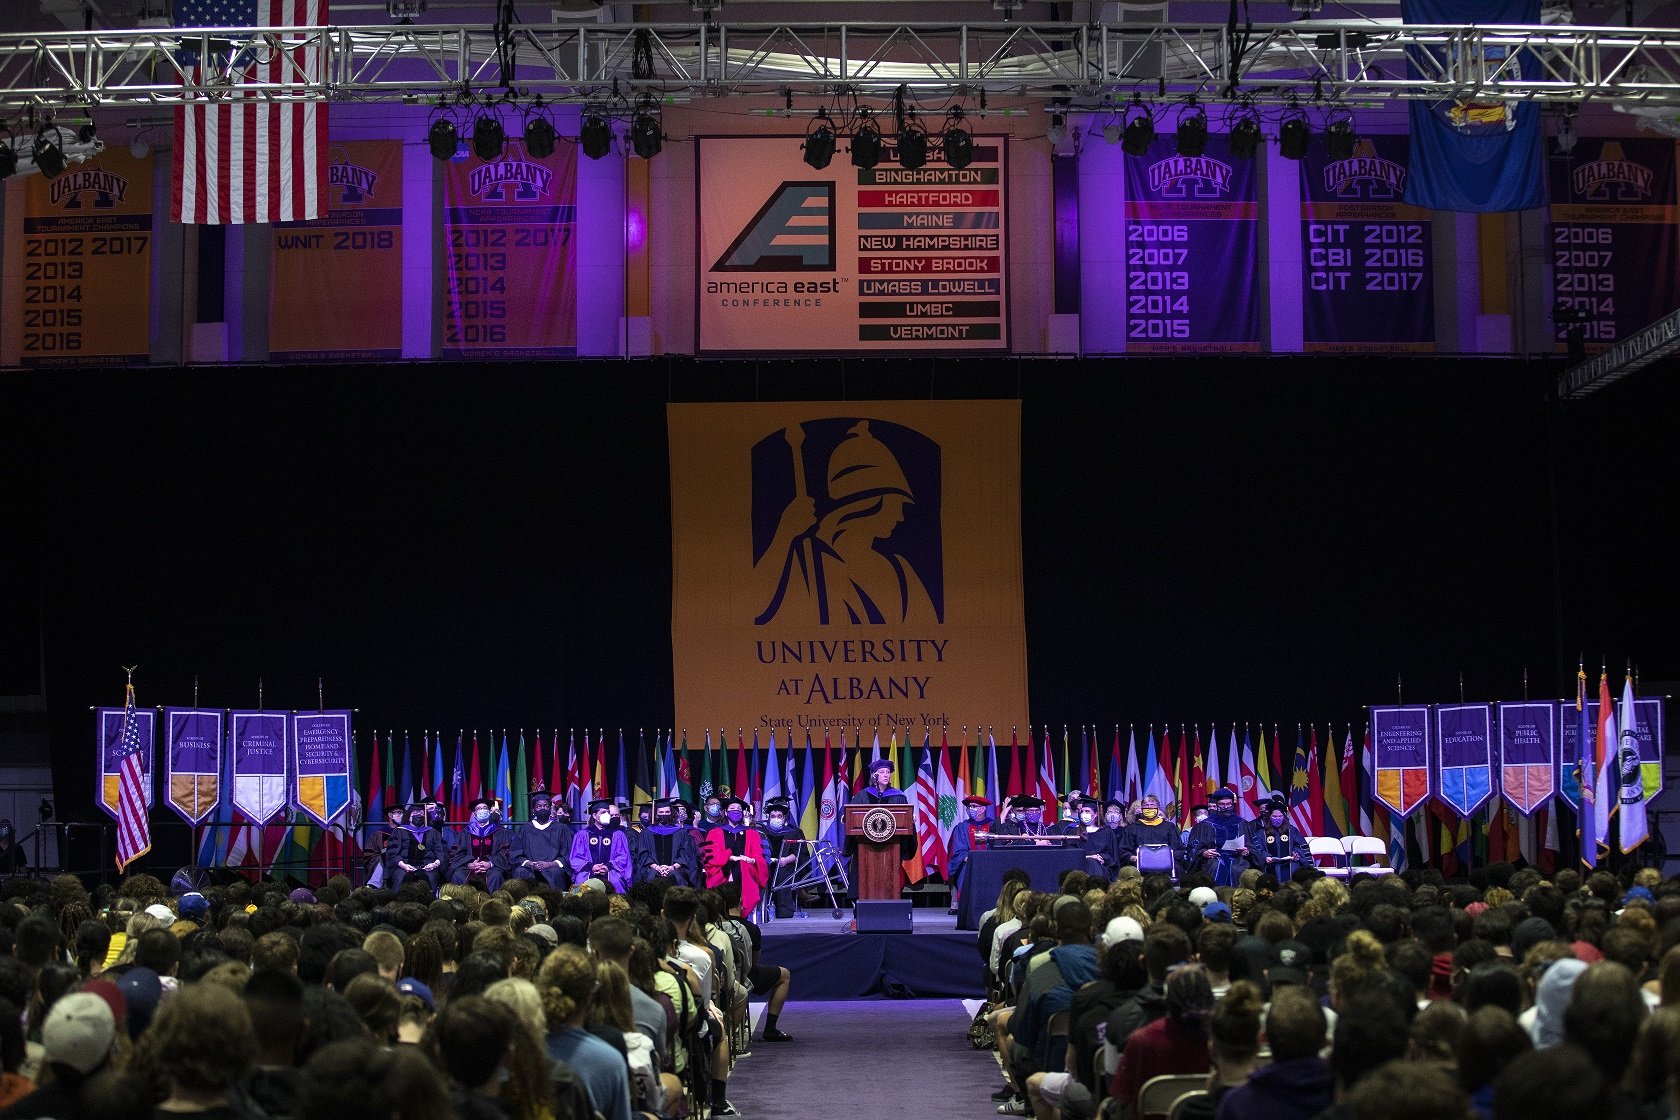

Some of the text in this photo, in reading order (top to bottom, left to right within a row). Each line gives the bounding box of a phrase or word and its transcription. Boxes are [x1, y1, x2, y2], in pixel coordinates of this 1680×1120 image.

[329, 165, 377, 198] BANY
[471, 161, 552, 196] UALBANY
[875, 170, 981, 183] BINGHAMTON
[1150, 157, 1232, 191] UALBANY
[1324, 158, 1405, 193] UALBANY
[1573, 160, 1654, 196] UALBANY
[50, 170, 128, 205] UALBANY
[885, 193, 973, 205] HARTFORD
[903, 214, 954, 227] MAINE
[279, 230, 393, 250] WNIT 2018
[450, 228, 571, 248] 2012 2017
[860, 236, 997, 249] NEW HAMPSHIRE
[1128, 225, 1188, 241] 2006
[1309, 224, 1423, 244] CIT 2012
[1554, 227, 1613, 244] 2006
[26, 236, 148, 257] 2012 2017
[448, 252, 507, 272] 2013
[870, 258, 988, 272] STONY BROOK
[1129, 248, 1188, 265] 2007
[1310, 248, 1424, 267] CBI 2016
[1555, 250, 1613, 267] 2007
[26, 261, 83, 280] 2013
[447, 276, 506, 295] 2014
[707, 281, 788, 294] america
[793, 277, 839, 293] east
[863, 281, 995, 293] UMASS LOWELL
[1129, 271, 1189, 290] 2013
[1310, 271, 1423, 291] CIT 2017
[1556, 273, 1614, 292] 2013
[25, 285, 82, 303] 2014
[721, 298, 822, 307] CONFERENCE
[446, 300, 506, 319] 2015
[906, 303, 953, 316] UMBC
[1129, 295, 1190, 314] 2014
[25, 308, 82, 327] 2015
[446, 324, 506, 342] 2016
[890, 326, 970, 338] VERMONT
[1129, 319, 1190, 338] 2015
[24, 332, 82, 351] 2016
[755, 639, 949, 664] UNIVERSITY
[776, 673, 932, 704] AT ALBANY
[760, 712, 950, 728] State University of New York
[1514, 737, 1540, 745] HEALTH
[1515, 729, 1539, 737] PUBLIC
[179, 741, 211, 749] BUSINESS
[243, 740, 277, 748] CRIMINAL
